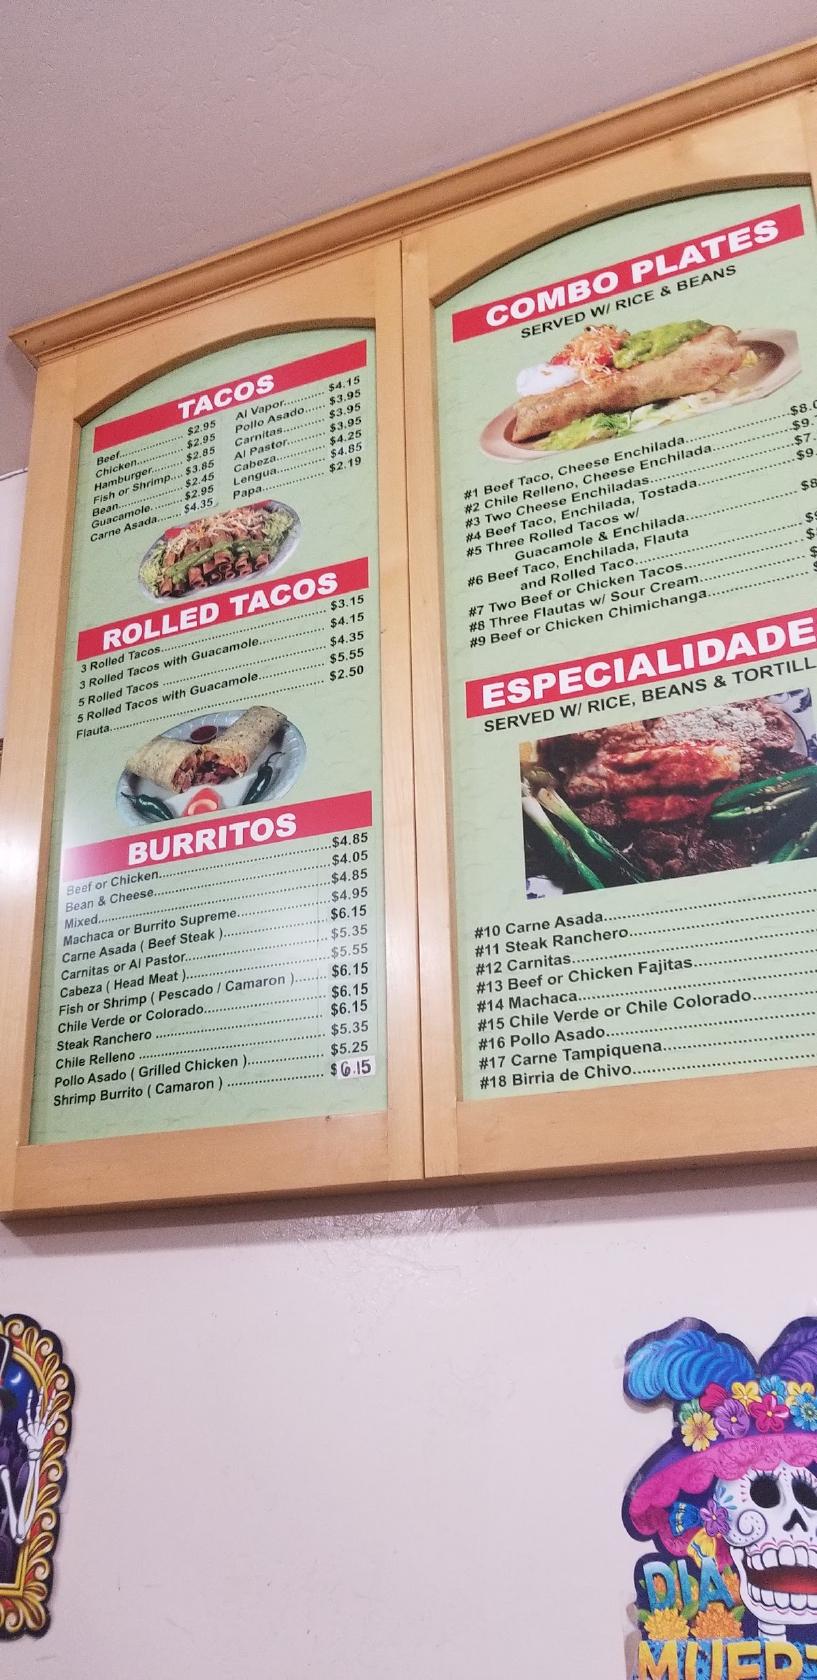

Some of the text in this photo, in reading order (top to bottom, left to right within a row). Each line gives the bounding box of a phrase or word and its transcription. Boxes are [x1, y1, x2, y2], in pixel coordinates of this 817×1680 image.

[486, 219, 778, 326] COMBO PLATES
[521, 265, 736, 338] SERVED RICE BEANS
[178, 374, 274, 419] TACOS
[236, 410, 247, 420] Al
[329, 376, 360, 392] $4.15
[236, 420, 264, 433] Pollo
[330, 389, 360, 406] $3.95
[330, 402, 360, 419] $3.95
[187, 433, 215, 449] $2.95
[188, 420, 216, 436] $2.95
[234, 450, 245, 460] Al
[330, 416, 361, 433] $3.95
[330, 429, 362, 450] $4.25
[186, 446, 215, 462] $2.85
[330, 456, 361, 473] $2.19
[331, 442, 362, 458] $4.85
[94, 491, 115, 504] Fish
[186, 460, 214, 476] $3.85
[185, 472, 214, 492] $2.45
[185, 485, 214, 505] $2.95
[484, 458, 609, 495] Beef Cheese
[485, 466, 634, 508] Chile Cheese
[90, 528, 120, 542] Carne
[184, 498, 213, 514] $4.35
[485, 498, 566, 523] Two Cheese
[486, 522, 516, 538] Beef
[486, 516, 619, 552] Three Rolled Tacos
[515, 536, 593, 560] Guacamole
[488, 530, 688, 582] Beef Flauta
[551, 565, 595, 584] Rolled
[103, 572, 338, 651] ROLLED TACOS
[488, 574, 634, 612] Two Beef Chicken
[489, 614, 528, 628] Three
[534, 601, 585, 619] Flautas
[611, 588, 645, 602] Sour
[89, 670, 123, 687] Rolled
[127, 664, 159, 677] Tacos
[164, 654, 187, 668] with
[330, 612, 364, 628] $4.15
[90, 594, 364, 670] Rolled $3.15
[491, 628, 522, 644] Beef
[546, 614, 603, 632] Chicken
[87, 704, 121, 721] Rolled
[125, 697, 158, 711] Tacos
[162, 689, 186, 702] with
[330, 648, 364, 664] $5.55
[88, 631, 364, 704] Rolled Tacos $4.35
[330, 665, 364, 681] $2.50
[484, 709, 554, 732] SERVED
[642, 679, 706, 702] BEANS
[128, 813, 296, 865] BURRITOS
[66, 850, 368, 912] Bean $4.05
[67, 832, 368, 896] Beef $4.85
[332, 868, 367, 884] $4.85
[62, 904, 366, 963] Carne Asada Beef Steak $6.15
[63, 931, 114, 946] Machaca
[134, 919, 176, 934] Burrito
[332, 886, 368, 902] $4.95
[506, 921, 550, 934] Carne
[61, 924, 368, 980] Carnitas Al $5.35
[506, 937, 548, 952] Steak
[59, 962, 368, 1016] Fish Shrimp Pescado Camaron $6.15
[60, 942, 368, 998] Cabeza Head Meat $5.55
[508, 974, 542, 990] Beef
[568, 966, 632, 982] Chicken
[57, 999, 367, 1051] Steak Ranchero $6.15
[58, 982, 368, 1033] Chile Verde $6.15
[510, 999, 667, 1028] Chile Verde Chile
[56, 1020, 368, 1069] Chile Relleno $5.35
[510, 1032, 550, 1047] Pollo
[511, 1053, 557, 1066] Carne
[55, 1040, 368, 1088] Pollo Asado Grilled Chicken $5.25
[512, 1071, 554, 1086] Birria
[54, 1093, 96, 1106] Shrimp
[100, 1086, 143, 1101] Burrito
[156, 1080, 214, 1094] Camaron
